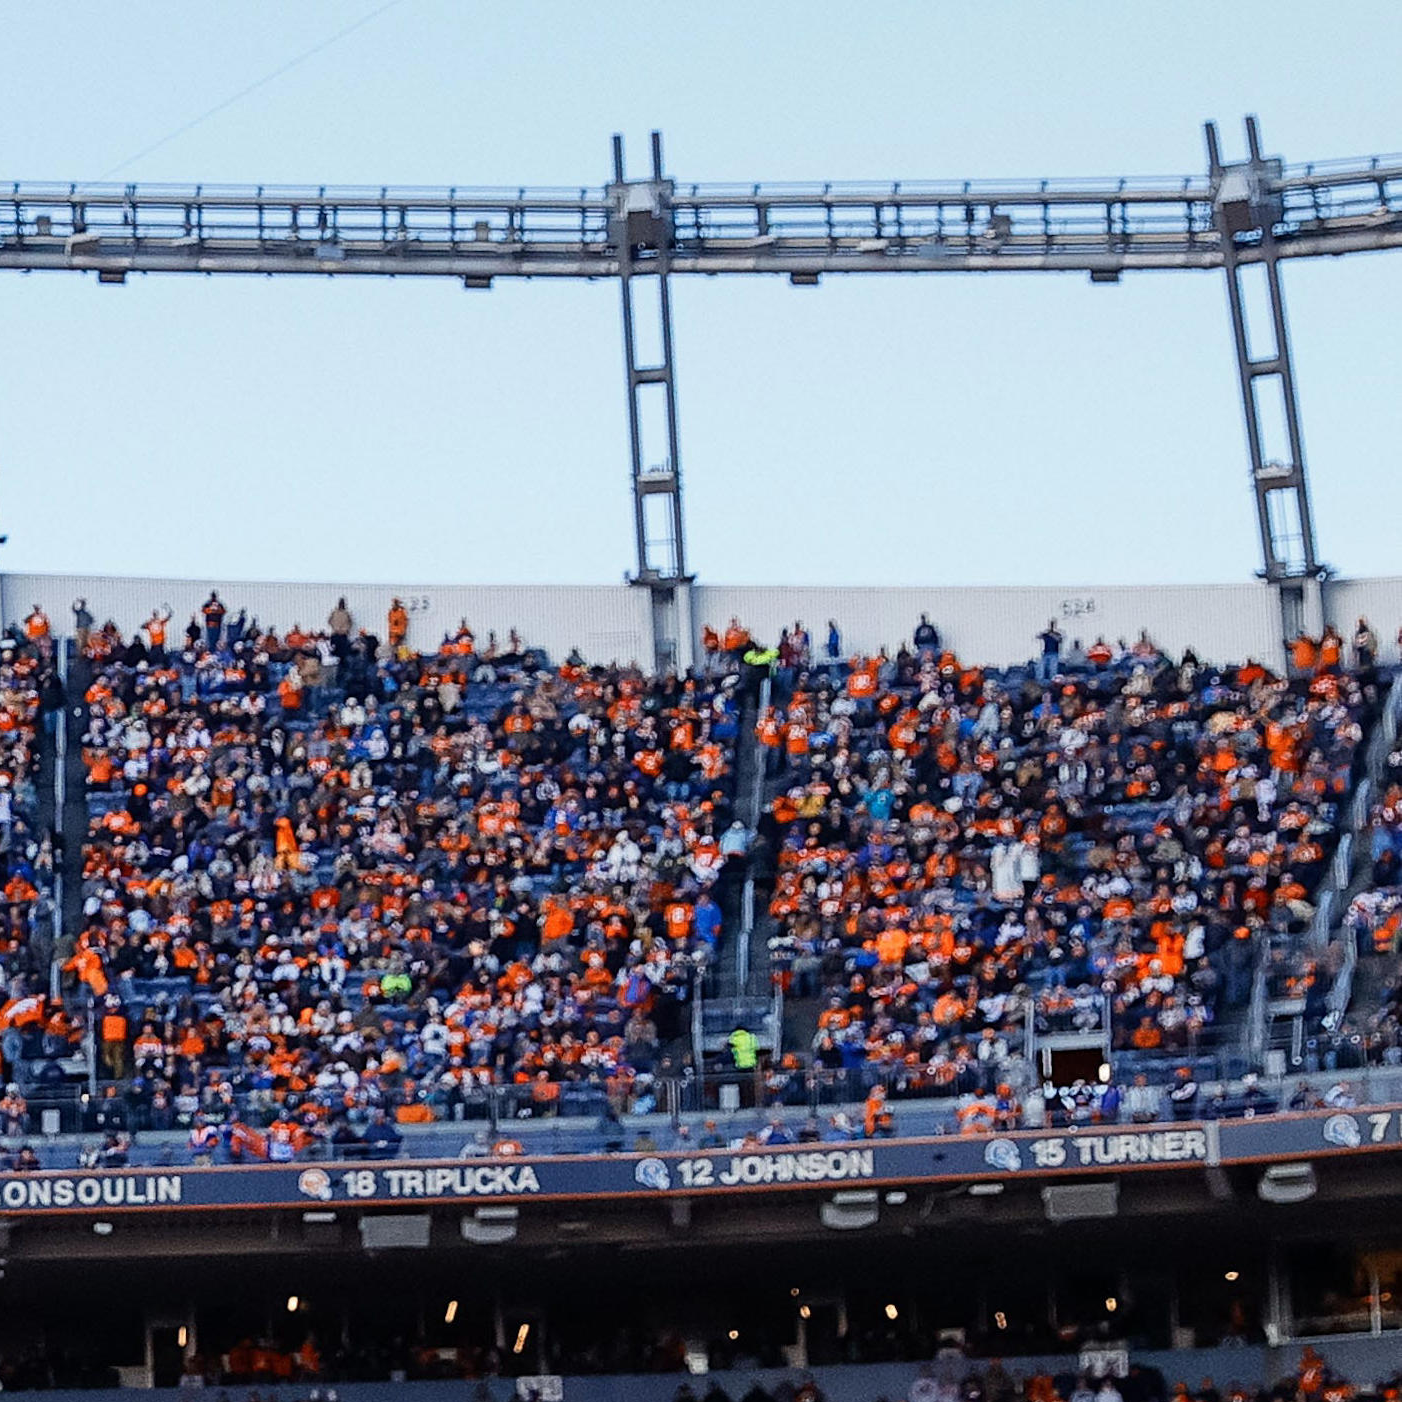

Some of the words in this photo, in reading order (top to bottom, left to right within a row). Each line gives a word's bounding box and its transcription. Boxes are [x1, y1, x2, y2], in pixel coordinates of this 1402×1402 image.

[1368, 1111, 1393, 1142] 7
[676, 1157, 714, 1186] 12
[719, 1147, 874, 1184] JOHNSON
[1029, 1136, 1067, 1168] 15
[1070, 1129, 1207, 1165] TURNER
[343, 1170, 375, 1197] 18
[383, 1164, 541, 1196] TRIPUCKA
